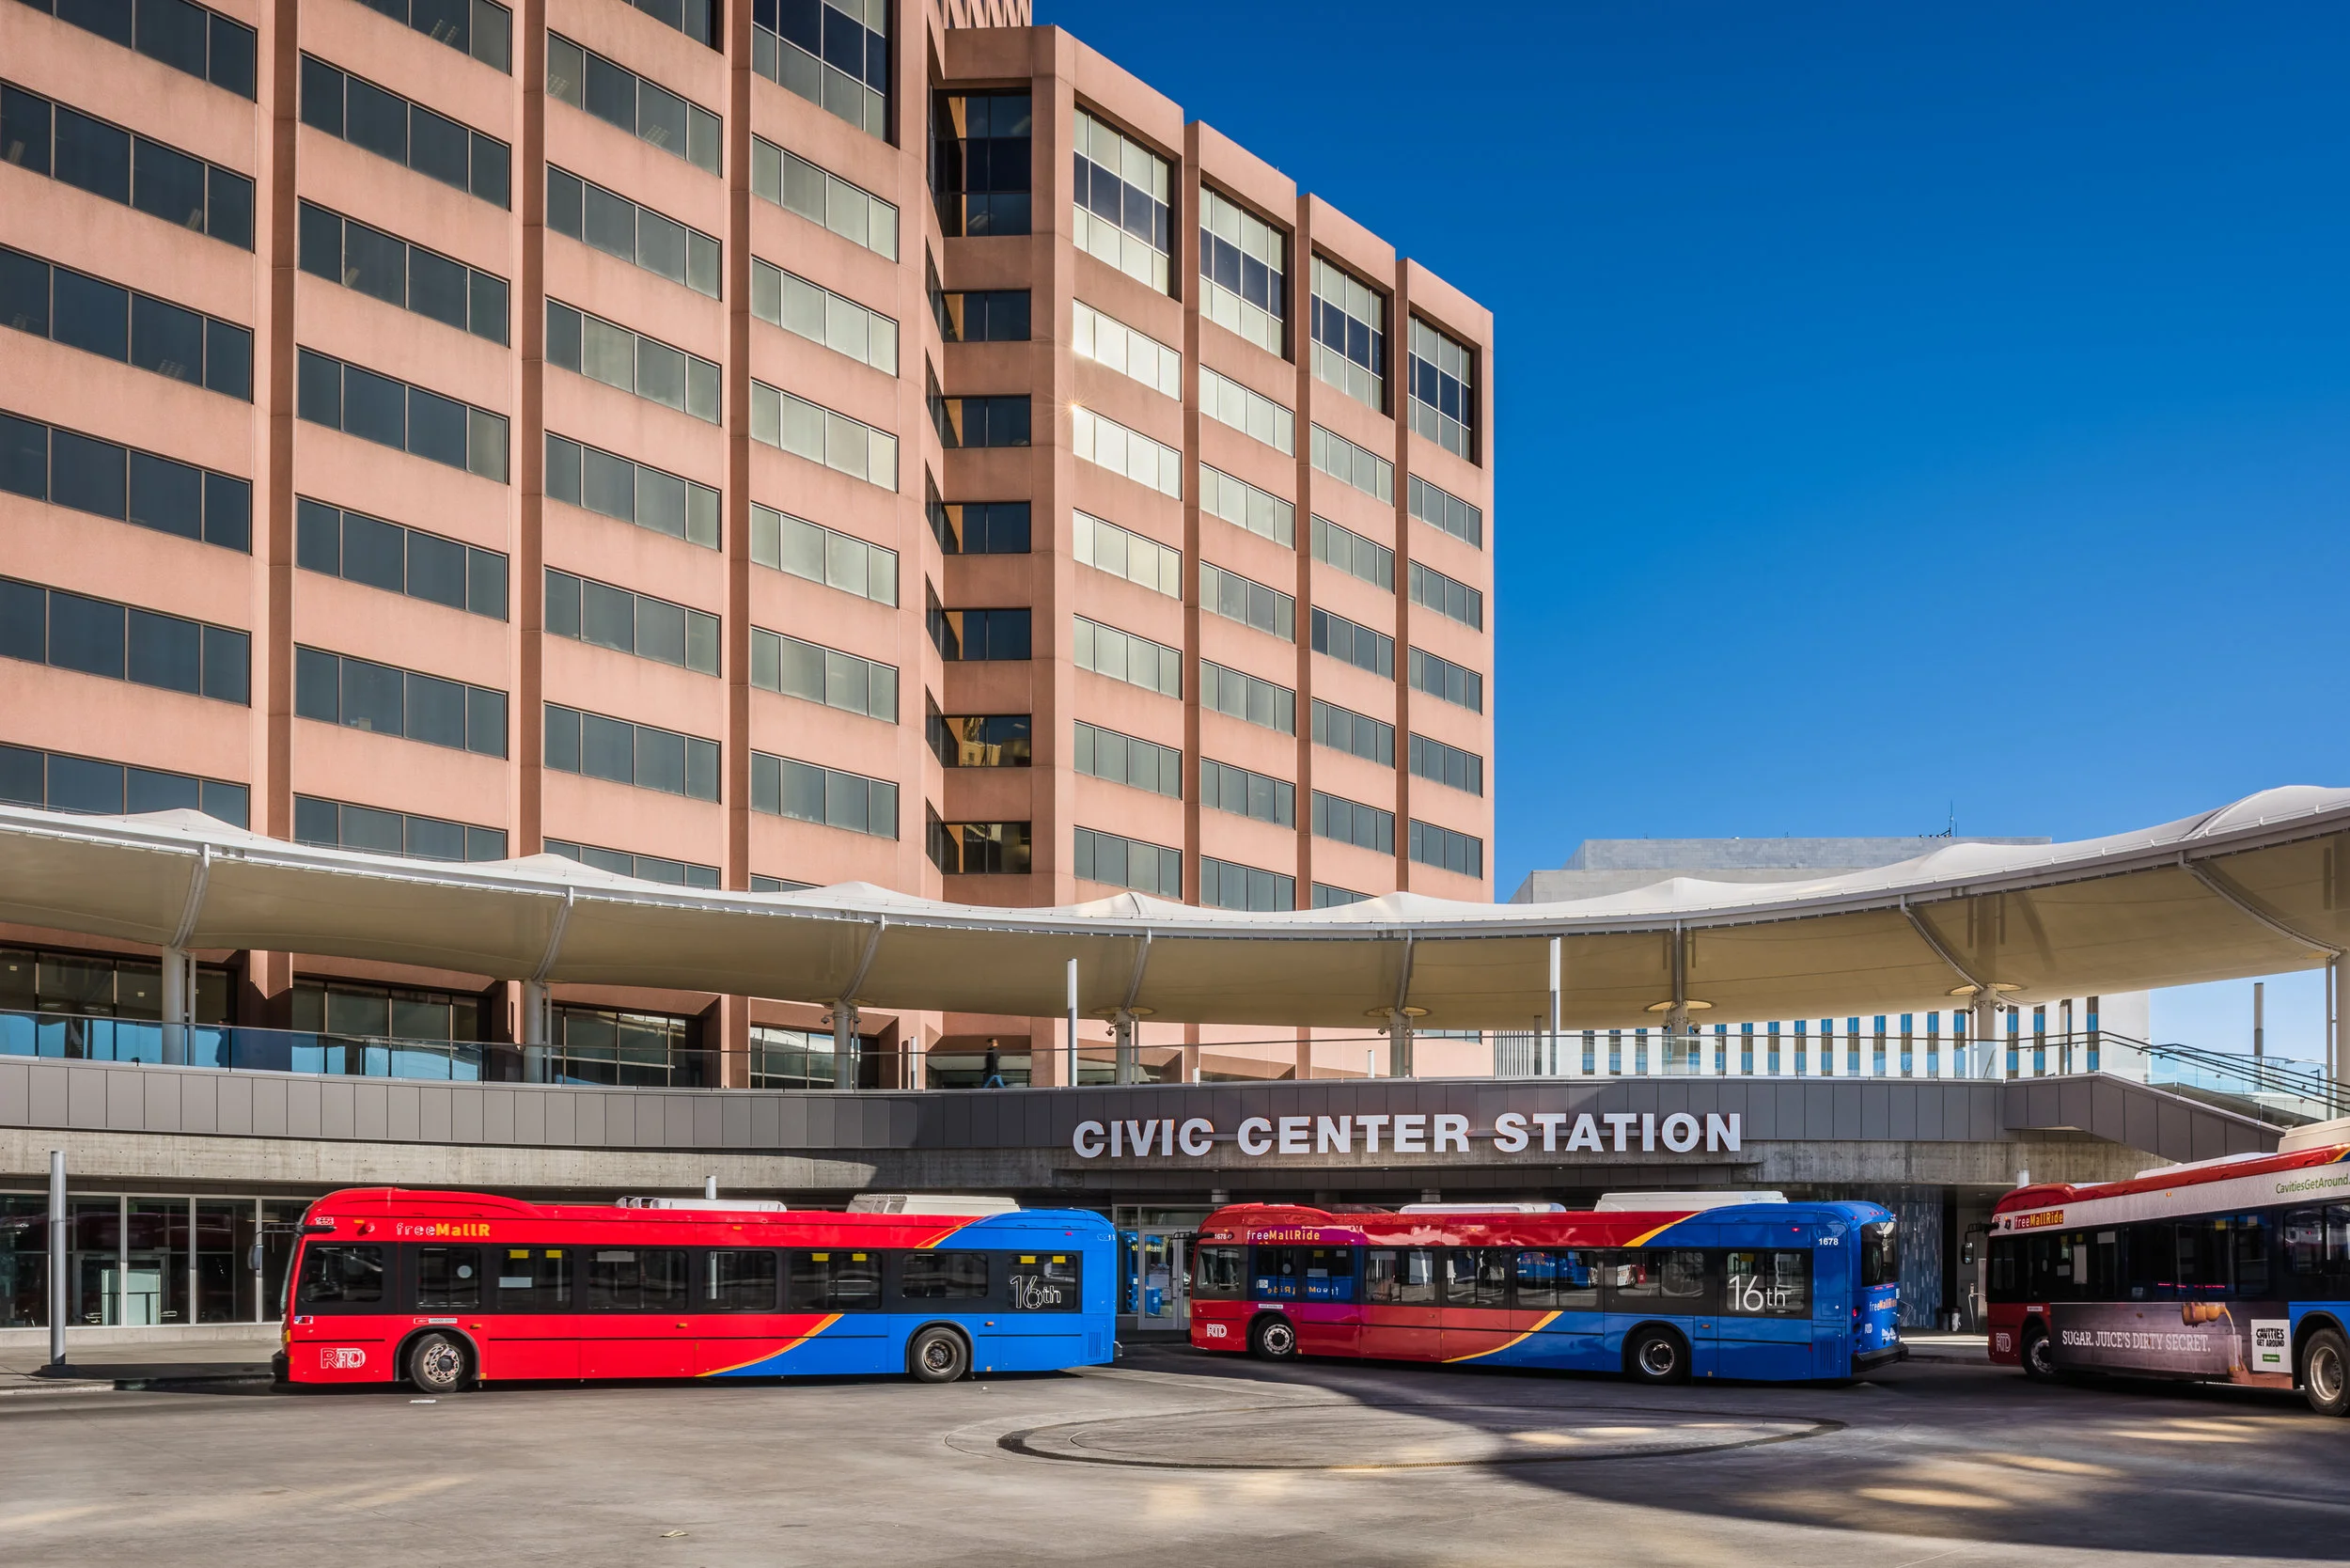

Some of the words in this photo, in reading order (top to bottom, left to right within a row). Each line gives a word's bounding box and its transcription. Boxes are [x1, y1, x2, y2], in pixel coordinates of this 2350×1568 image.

[1073, 1118, 1214, 1157] CIVIC
[1236, 1113, 1470, 1155] CENTER
[1494, 1112, 1741, 1153] STATION
[2014, 1212, 2063, 1228] freeMallRide
[396, 1223, 491, 1236] freeMallR
[1246, 1230, 1321, 1240] freeMallRide
[1818, 1237, 1839, 1246] 1678
[1010, 1275, 1061, 1309] 16th
[1729, 1275, 1786, 1311] 16th
[1207, 1324, 1228, 1338] RTD
[2256, 1327, 2284, 1340] CAVITIES
[1996, 1333, 2012, 1353] RTD
[2062, 1330, 2094, 1347] SUGAR.
[2095, 1331, 2131, 1348] JUICE'S
[2132, 1332, 2163, 1351] DIRTY
[2166, 1333, 2211, 1353] SECRET.
[2256, 1339, 2265, 1347] GET
[2265, 1339, 2285, 1347] AROUND
